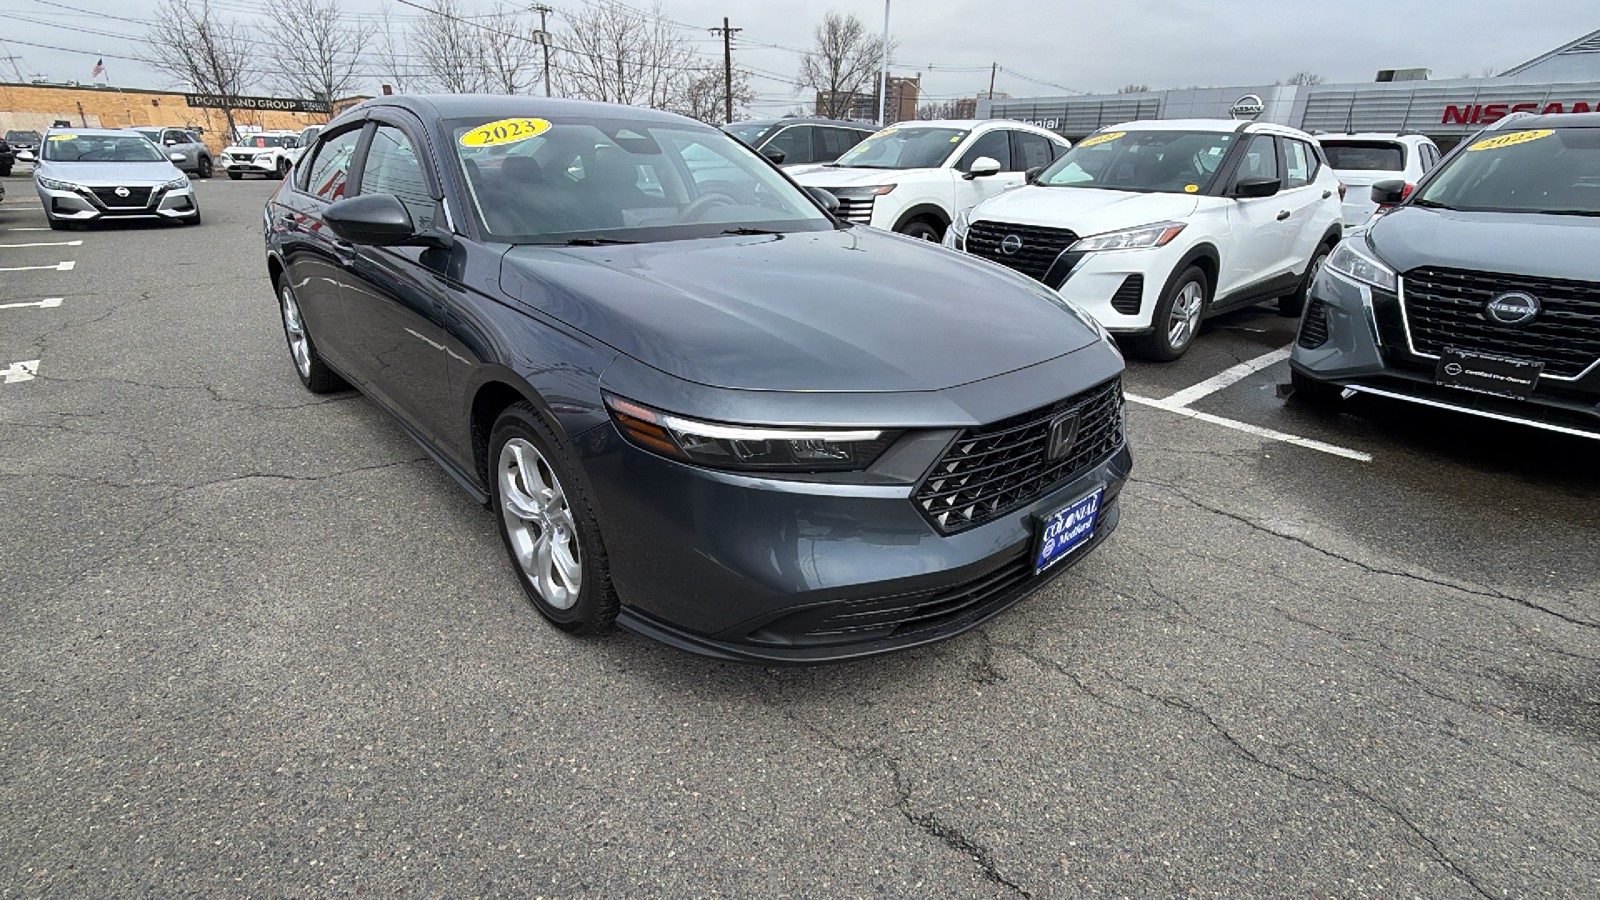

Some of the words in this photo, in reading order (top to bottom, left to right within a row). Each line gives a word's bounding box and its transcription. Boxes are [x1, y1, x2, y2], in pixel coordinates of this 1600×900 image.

[258, 98, 296, 110] GROUP
[478, 120, 537, 144] 2023
[1487, 302, 1537, 315] NISSAN
[1465, 369, 1493, 379] Certified
[1492, 374, 1531, 385] Pre-Owned
[1043, 498, 1099, 542] COLONIAL
